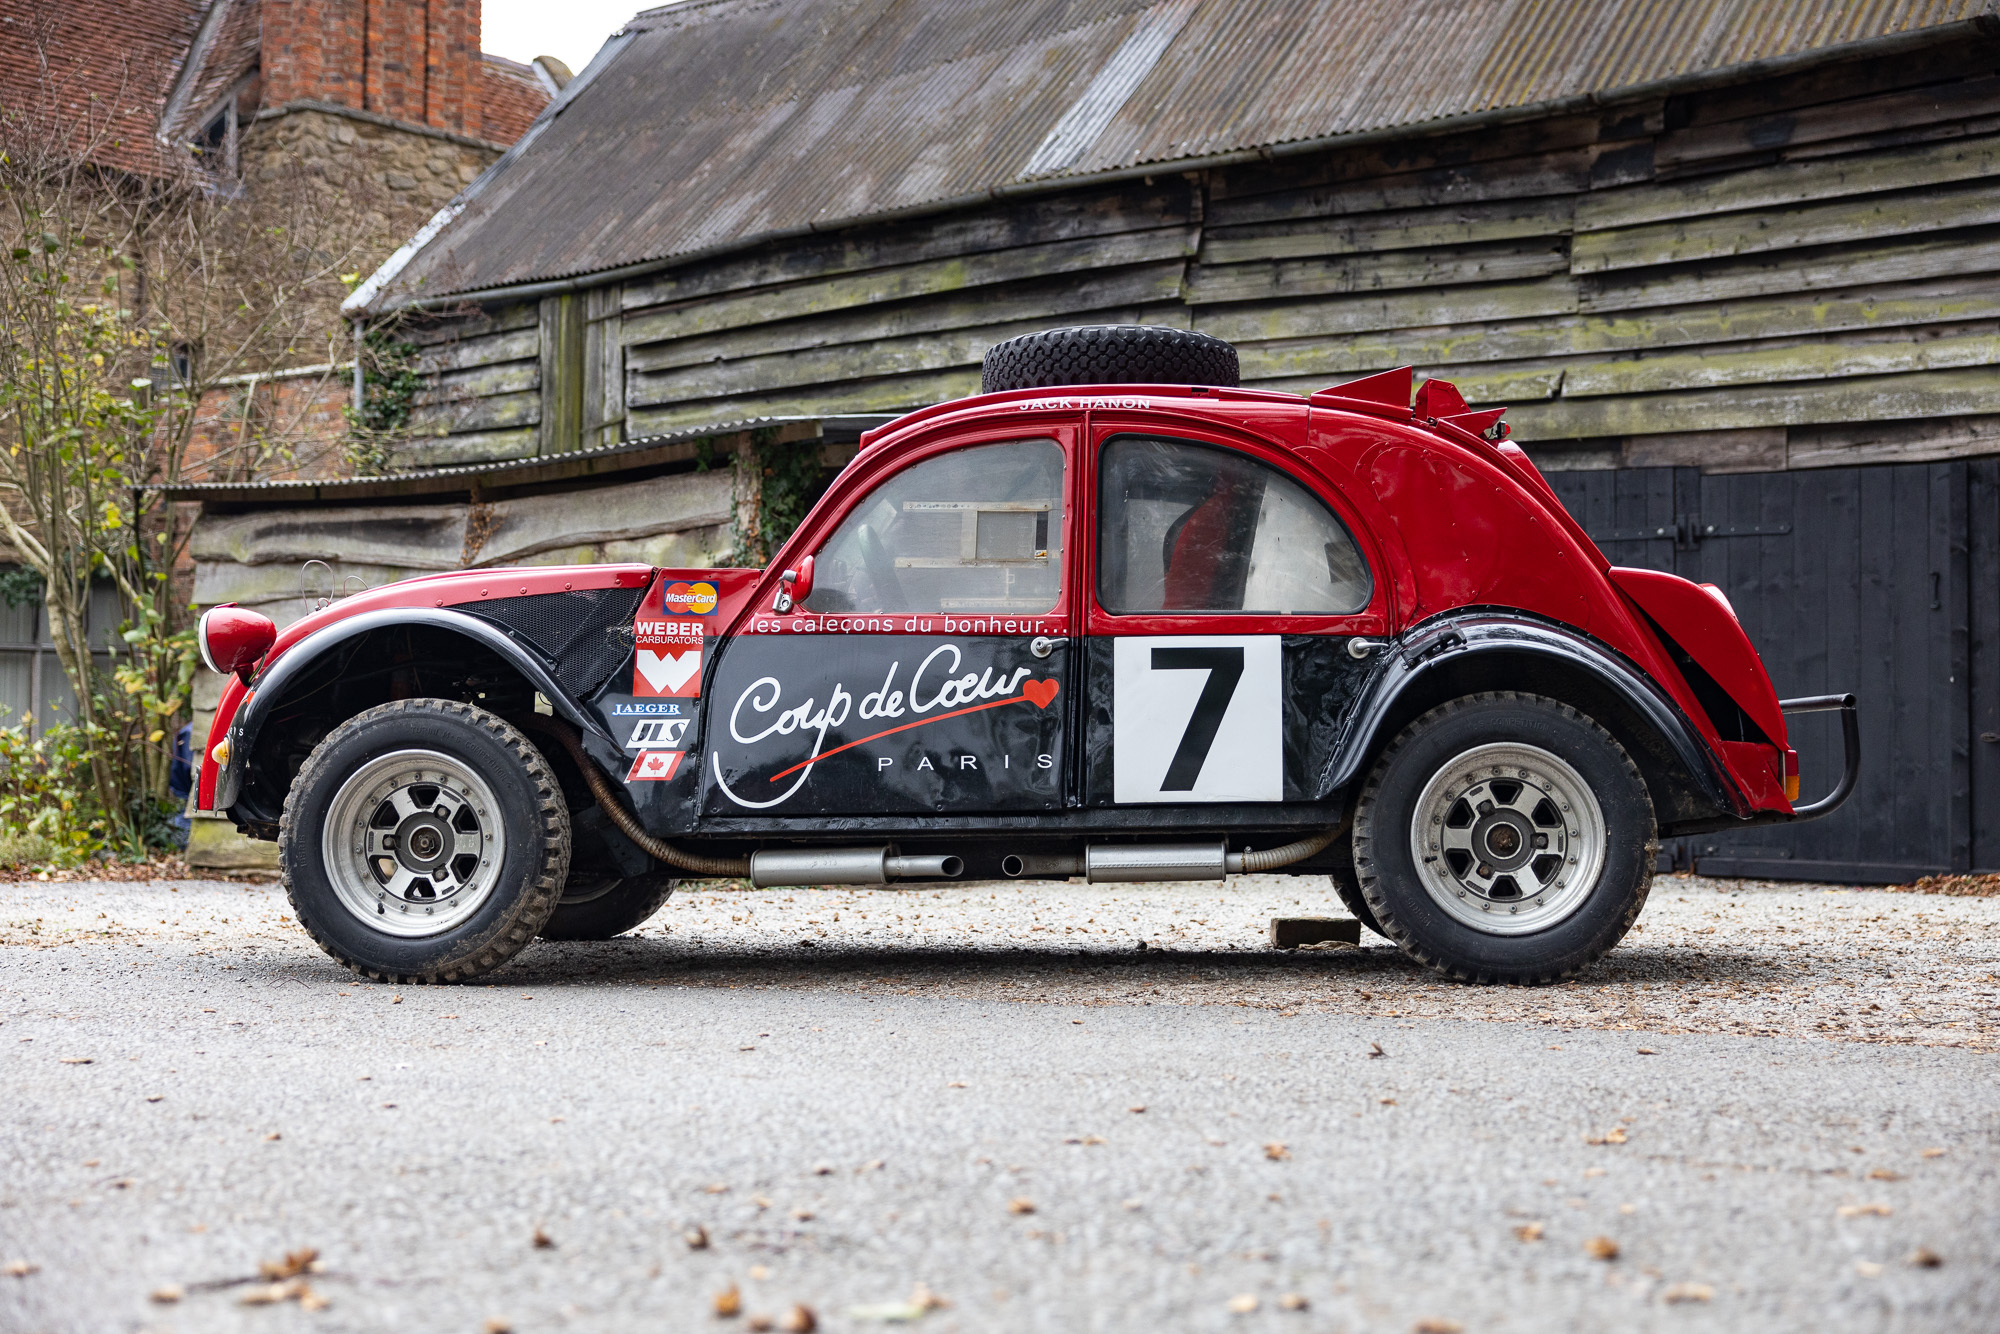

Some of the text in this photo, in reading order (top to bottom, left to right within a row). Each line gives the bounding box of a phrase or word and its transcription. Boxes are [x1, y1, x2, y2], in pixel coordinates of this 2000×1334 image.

[1019, 398, 1150, 410] JACK HANON
[665, 593, 716, 603] MasterCard
[637, 622, 704, 636] WEBER
[750, 616, 782, 633] les
[791, 615, 894, 635] caleçons
[904, 615, 932, 633] du
[635, 636, 704, 645] CARBURATORS
[612, 703, 682, 716] JAEGER
[1150, 646, 1245, 792] 7
[713, 676, 852, 809] Coup
[858, 660, 905, 720] de
[878, 753, 1053, 771] PARIS
